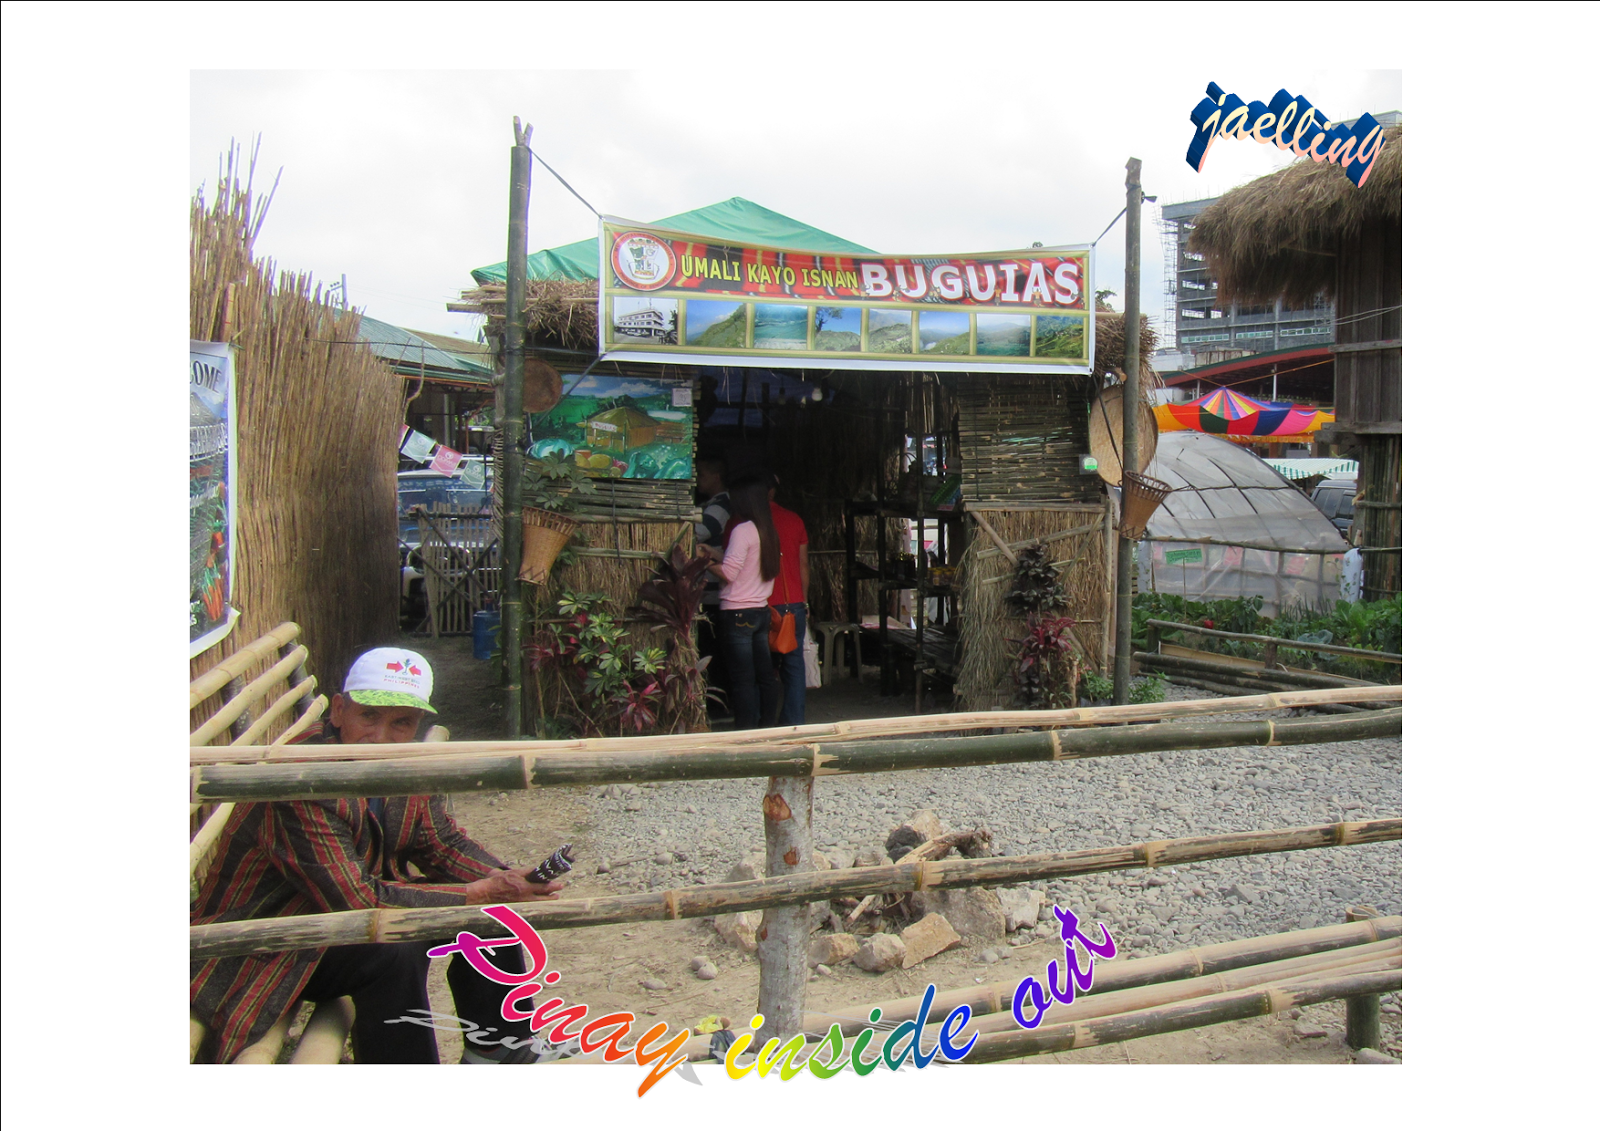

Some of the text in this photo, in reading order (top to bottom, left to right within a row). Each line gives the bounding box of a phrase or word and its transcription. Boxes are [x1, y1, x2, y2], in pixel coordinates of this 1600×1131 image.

[681, 254, 741, 282] UMALI
[747, 262, 796, 286] KAYO
[802, 268, 859, 289] ISNAN
[862, 261, 1080, 304] BUGUIAS
